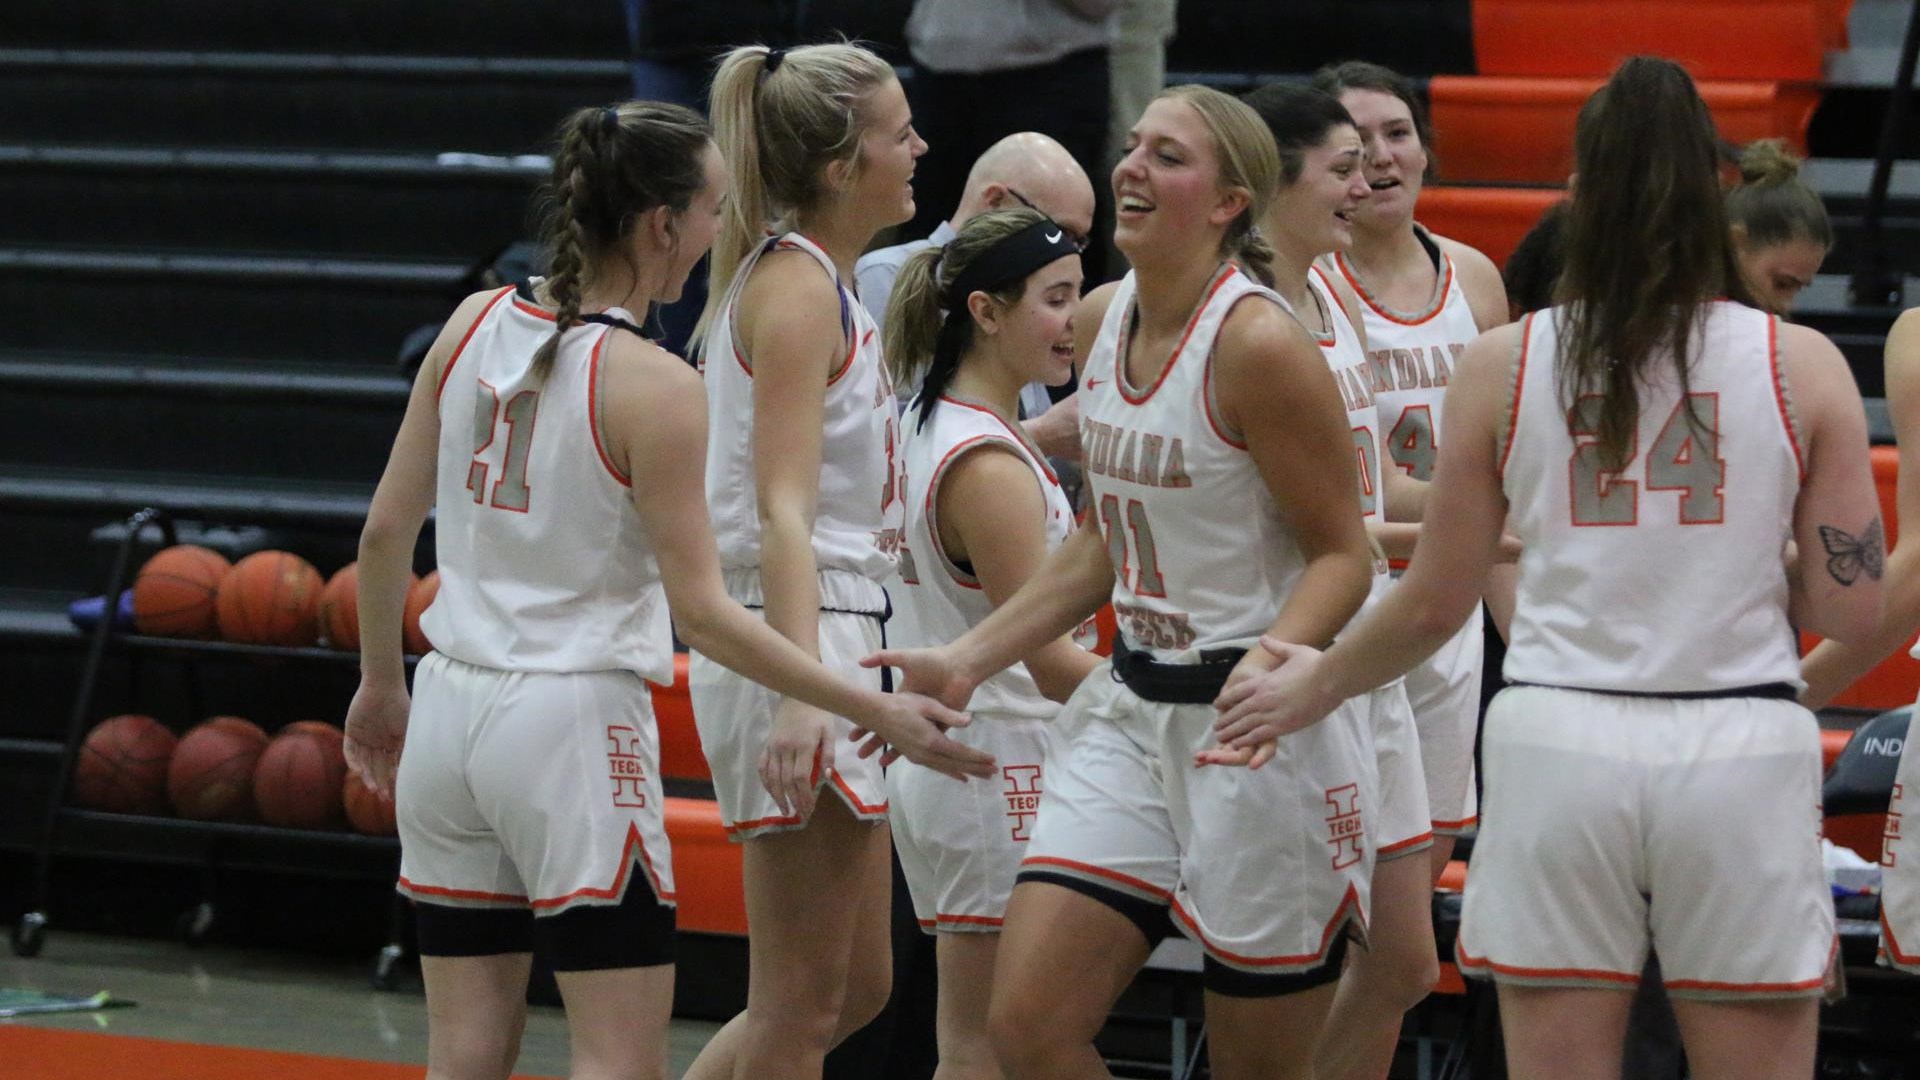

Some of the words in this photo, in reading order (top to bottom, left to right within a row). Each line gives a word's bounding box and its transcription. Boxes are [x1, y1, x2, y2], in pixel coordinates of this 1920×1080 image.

[1368, 344, 1464, 392] NDIA
[1568, 392, 1726, 526] 24
[1101, 494, 1166, 599] 11
[609, 759, 643, 775] TECH
[1329, 816, 1362, 837] TECH
